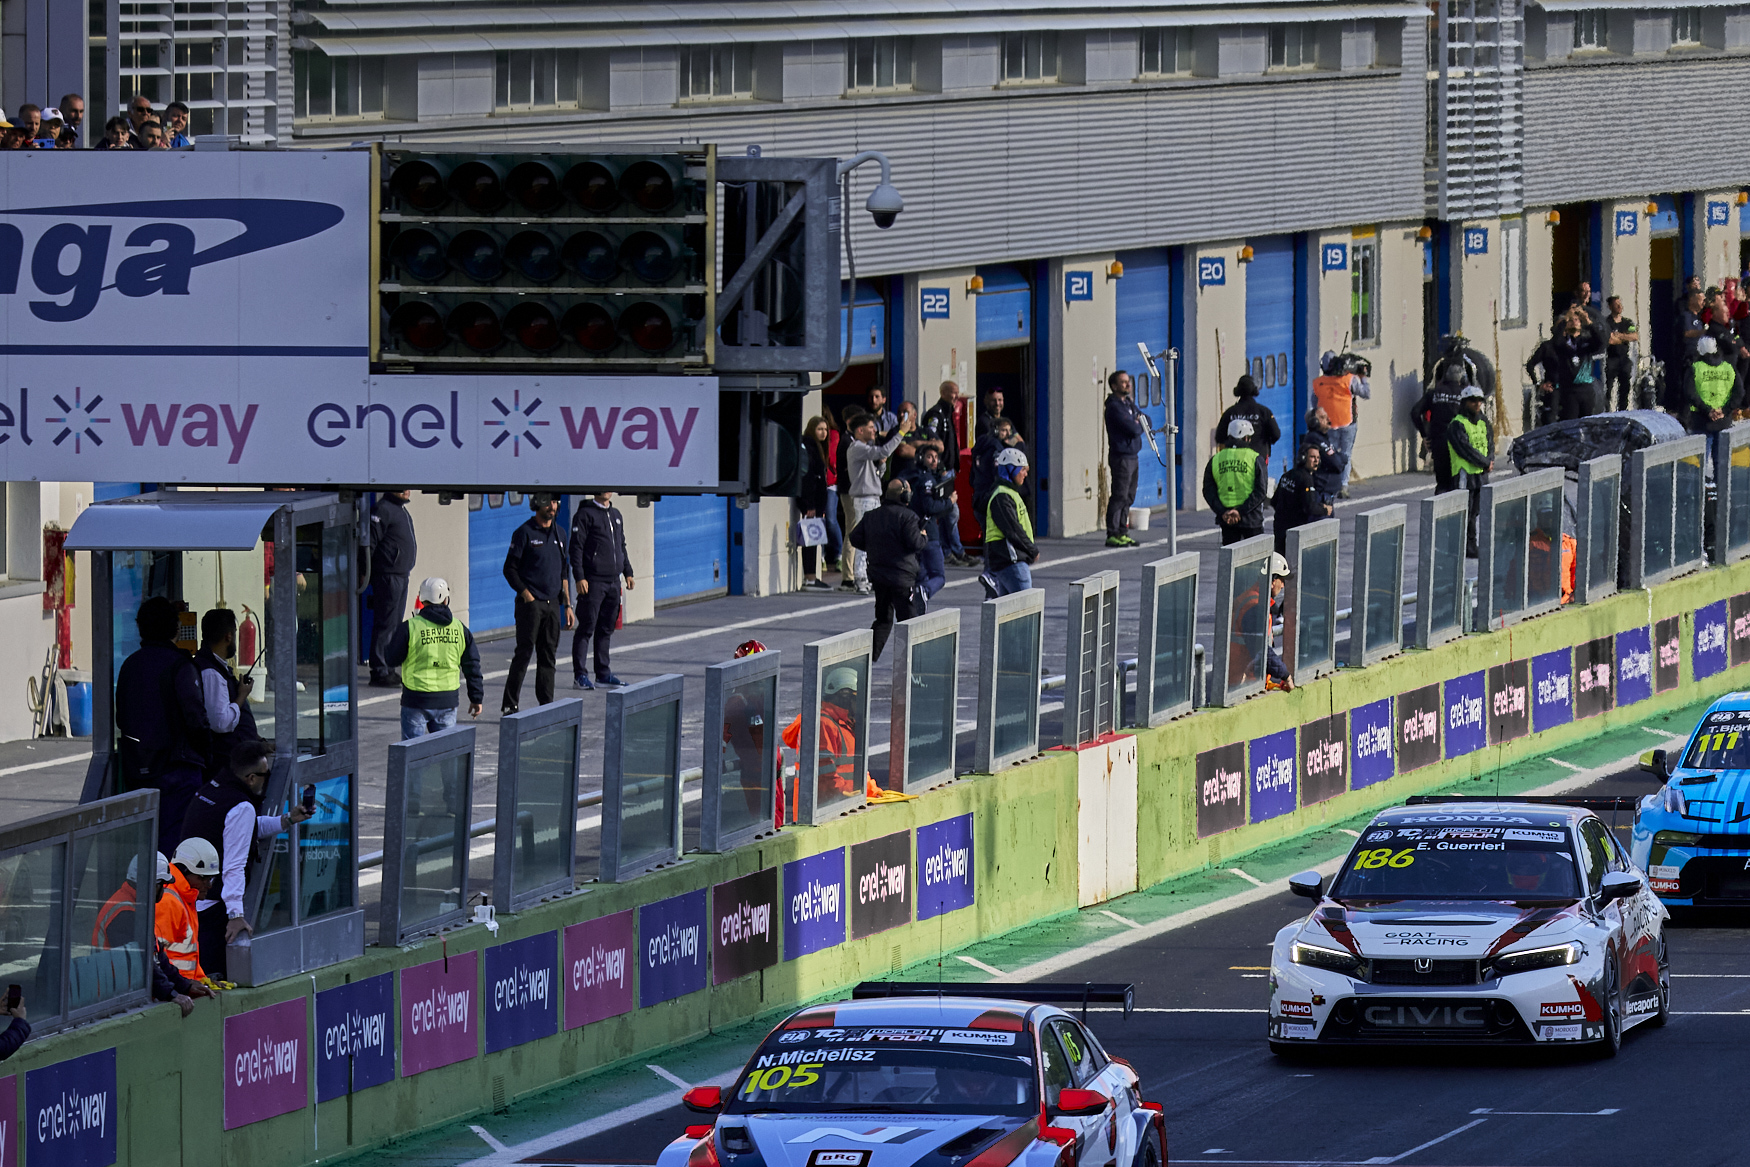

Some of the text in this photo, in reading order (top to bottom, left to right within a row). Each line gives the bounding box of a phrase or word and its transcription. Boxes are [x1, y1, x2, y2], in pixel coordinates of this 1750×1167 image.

[1617, 215, 1637, 234] 16
[1325, 247, 1344, 264] 19
[1467, 231, 1487, 250] 18
[1201, 262, 1224, 280] 20
[1071, 278, 1090, 295] 21
[924, 295, 948, 313] 22
[120, 403, 259, 464] way
[307, 390, 699, 467] enel way
[420, 628, 459, 637] SERVIZIO
[421, 635, 459, 645] CONTROLLO
[1404, 709, 1436, 743] enel way
[1450, 695, 1482, 730] enel way
[1357, 724, 1392, 758] enel way
[1699, 732, 1740, 752] 111
[1307, 741, 1344, 776] enel way
[1204, 769, 1241, 806] enel way
[1255, 756, 1293, 792] enel way
[1400, 815, 1532, 825] HONDA
[1353, 848, 1416, 870] 186
[1417, 841, 1505, 851] E. Guerrieri
[925, 846, 968, 885] enel way
[859, 861, 905, 904] enel way
[1649, 880, 1680, 890] KUMHO
[792, 881, 840, 924] enel way
[721, 902, 770, 946] enel way
[648, 924, 699, 968] enel way
[1400, 938, 1469, 946] RACING
[573, 946, 625, 991] enel way
[494, 967, 550, 1012] enel way
[412, 989, 469, 1034] enel way
[1281, 1003, 1311, 1014] KUMHO
[1364, 1006, 1485, 1025] CIVIC
[1541, 1004, 1582, 1014] KUMHO
[325, 1012, 386, 1060] enel way
[235, 1038, 298, 1086] enel way
[756, 1048, 876, 1069] N.Michelisz
[744, 1064, 824, 1094] 105
[38, 1091, 106, 1143] enel way
[822, 1153, 856, 1162] BRC
